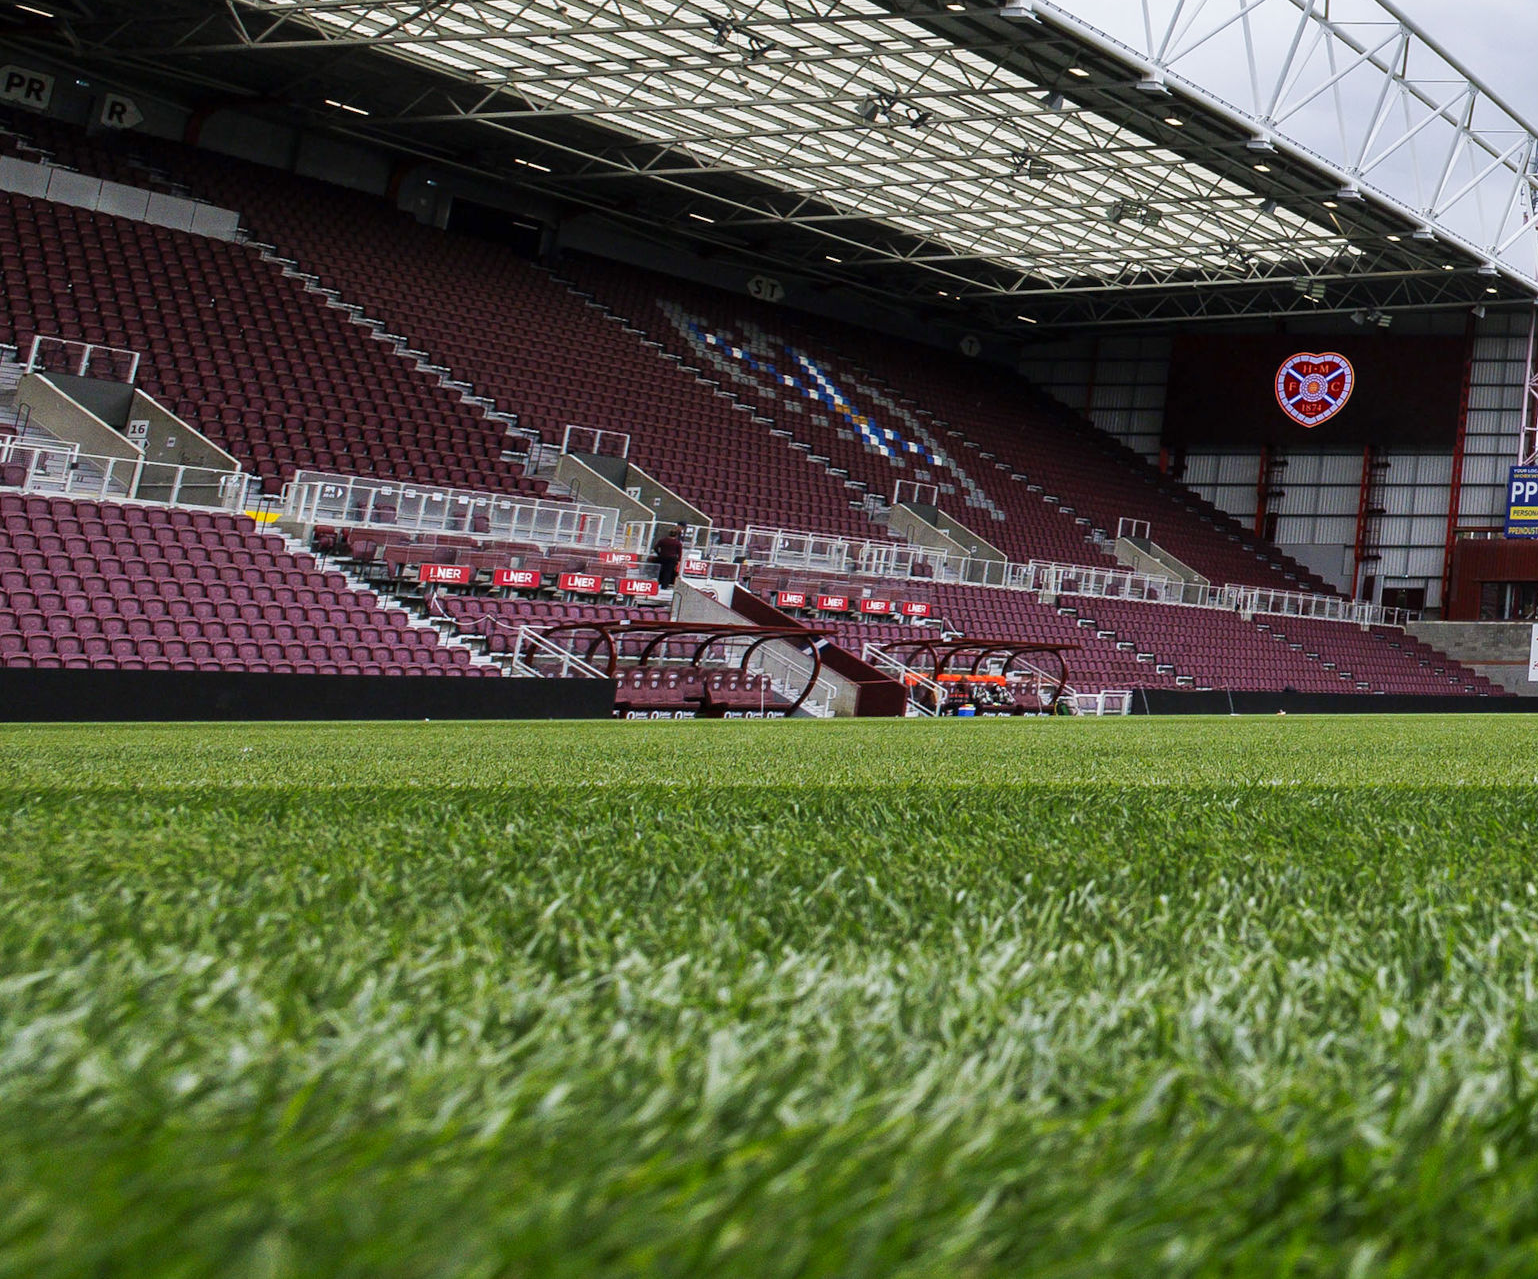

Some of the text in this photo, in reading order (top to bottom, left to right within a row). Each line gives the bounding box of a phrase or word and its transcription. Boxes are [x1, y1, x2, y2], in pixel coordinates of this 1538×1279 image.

[5, 72, 45, 101] PR
[108, 101, 127, 124] R
[755, 280, 776, 298] S T
[1289, 382, 1297, 391] F
[1331, 382, 1340, 391] C
[1301, 403, 1322, 412] 1874
[130, 424, 146, 434] 16
[606, 553, 631, 562] LNER
[684, 558, 707, 571] LNER
[429, 567, 462, 579] LNER
[502, 571, 532, 583] LNER
[568, 575, 595, 588] LNER
[627, 581, 653, 592] LNER
[782, 593, 804, 604] LNER
[823, 597, 844, 608] LNER
[866, 601, 886, 611] LNER
[908, 603, 927, 614] LNER
